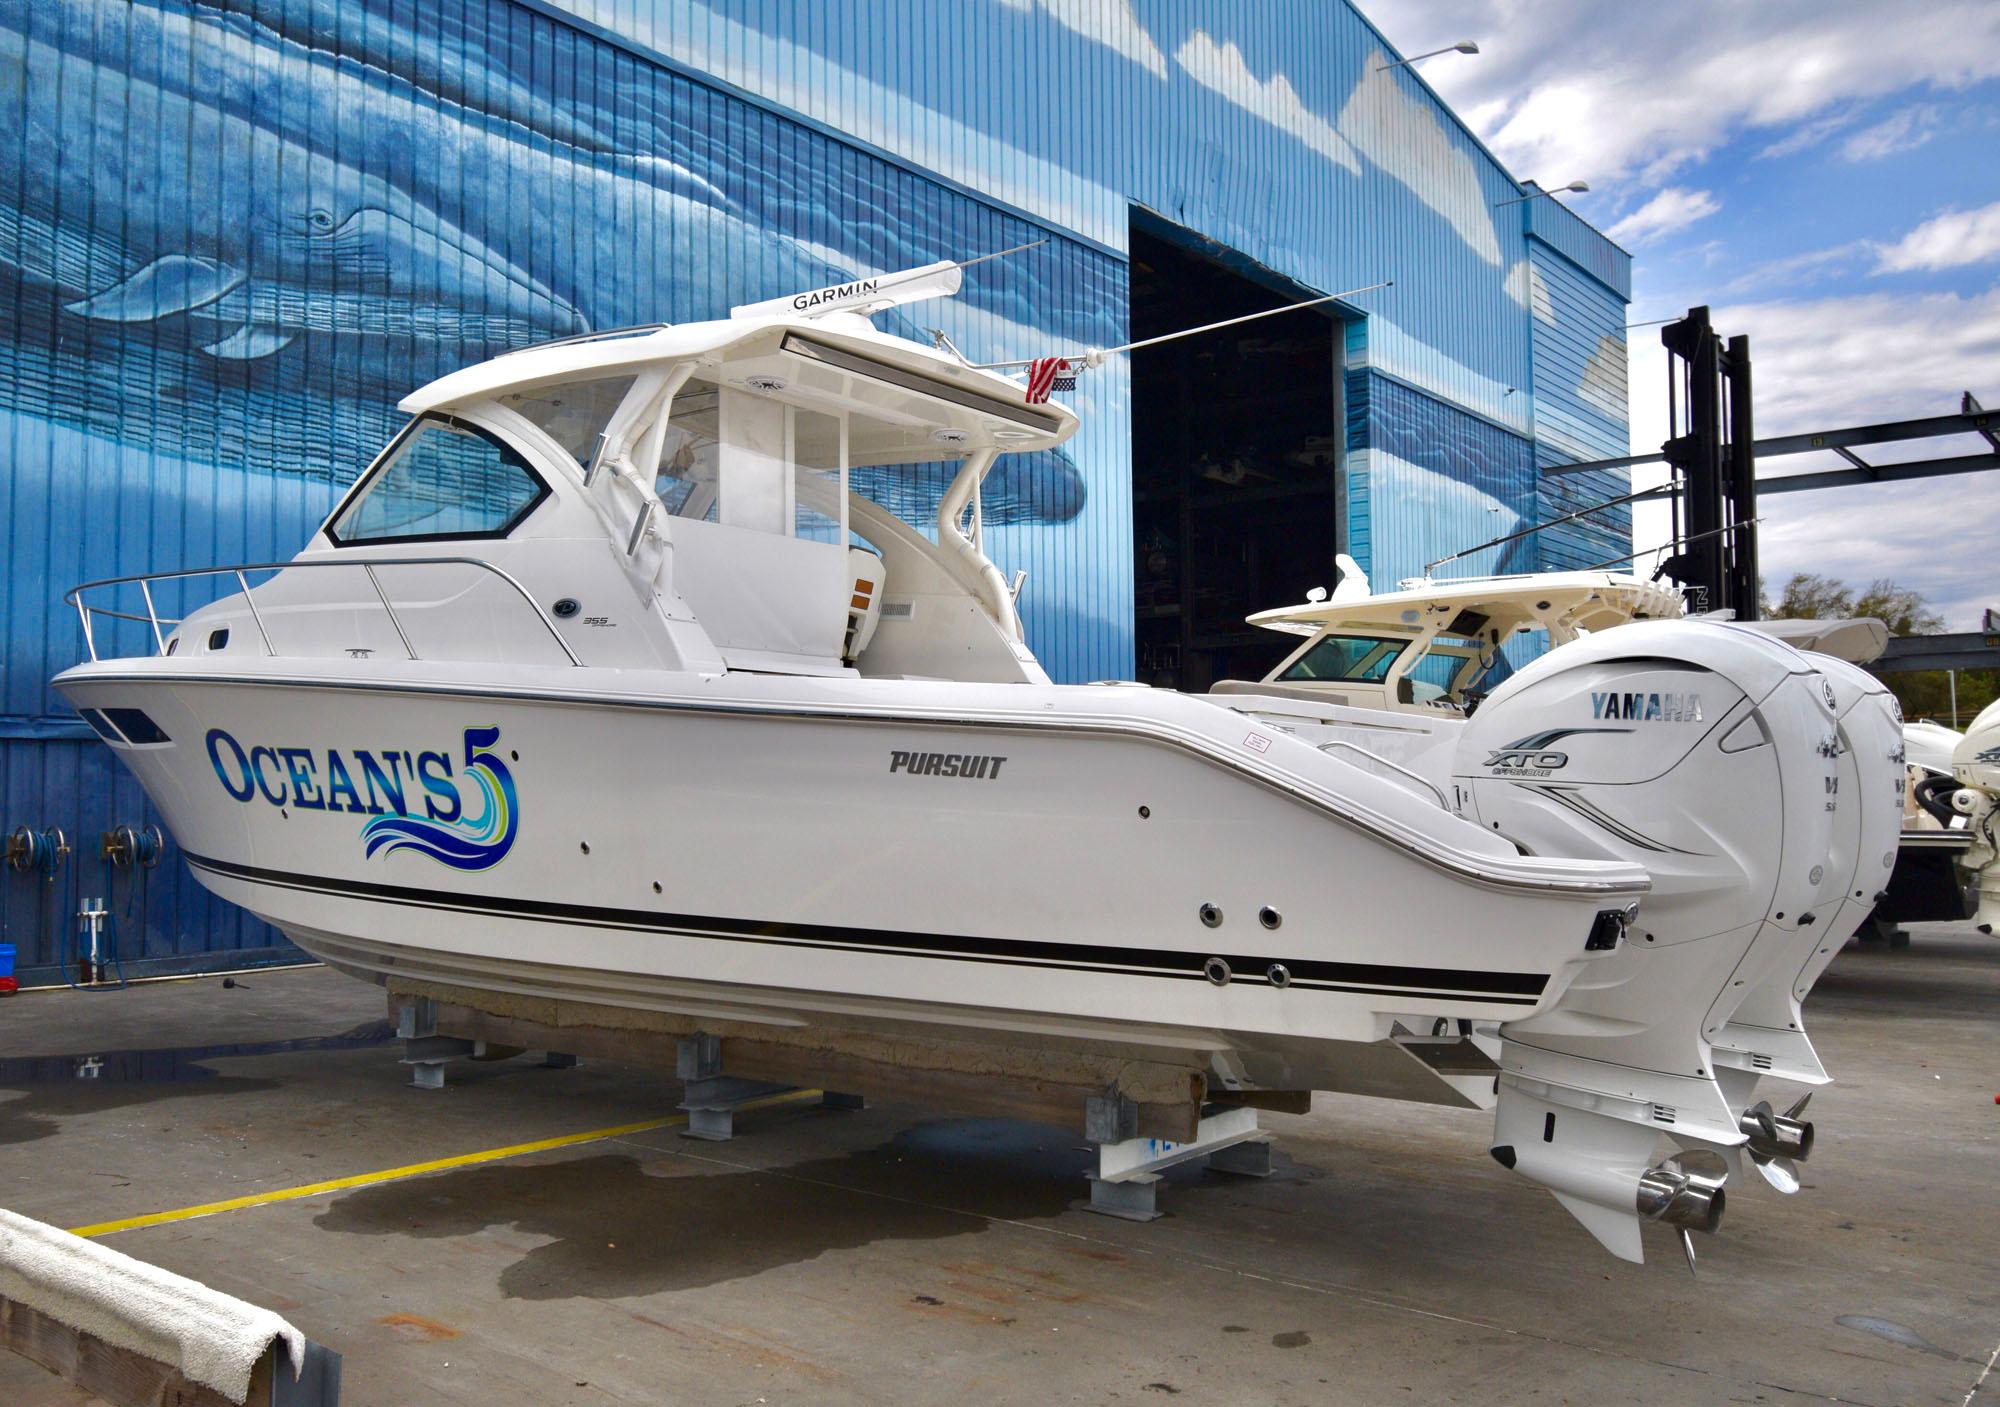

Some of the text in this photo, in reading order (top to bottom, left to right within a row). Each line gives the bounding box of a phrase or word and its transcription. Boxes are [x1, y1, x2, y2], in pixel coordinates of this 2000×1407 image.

[793, 279, 878, 310] GARMIN
[1591, 692, 1703, 722] YAMAHA
[889, 750, 1008, 780] PURSUIT
[1481, 750, 1569, 769] XTO
[205, 723, 520, 873] OCEAN'S 5
